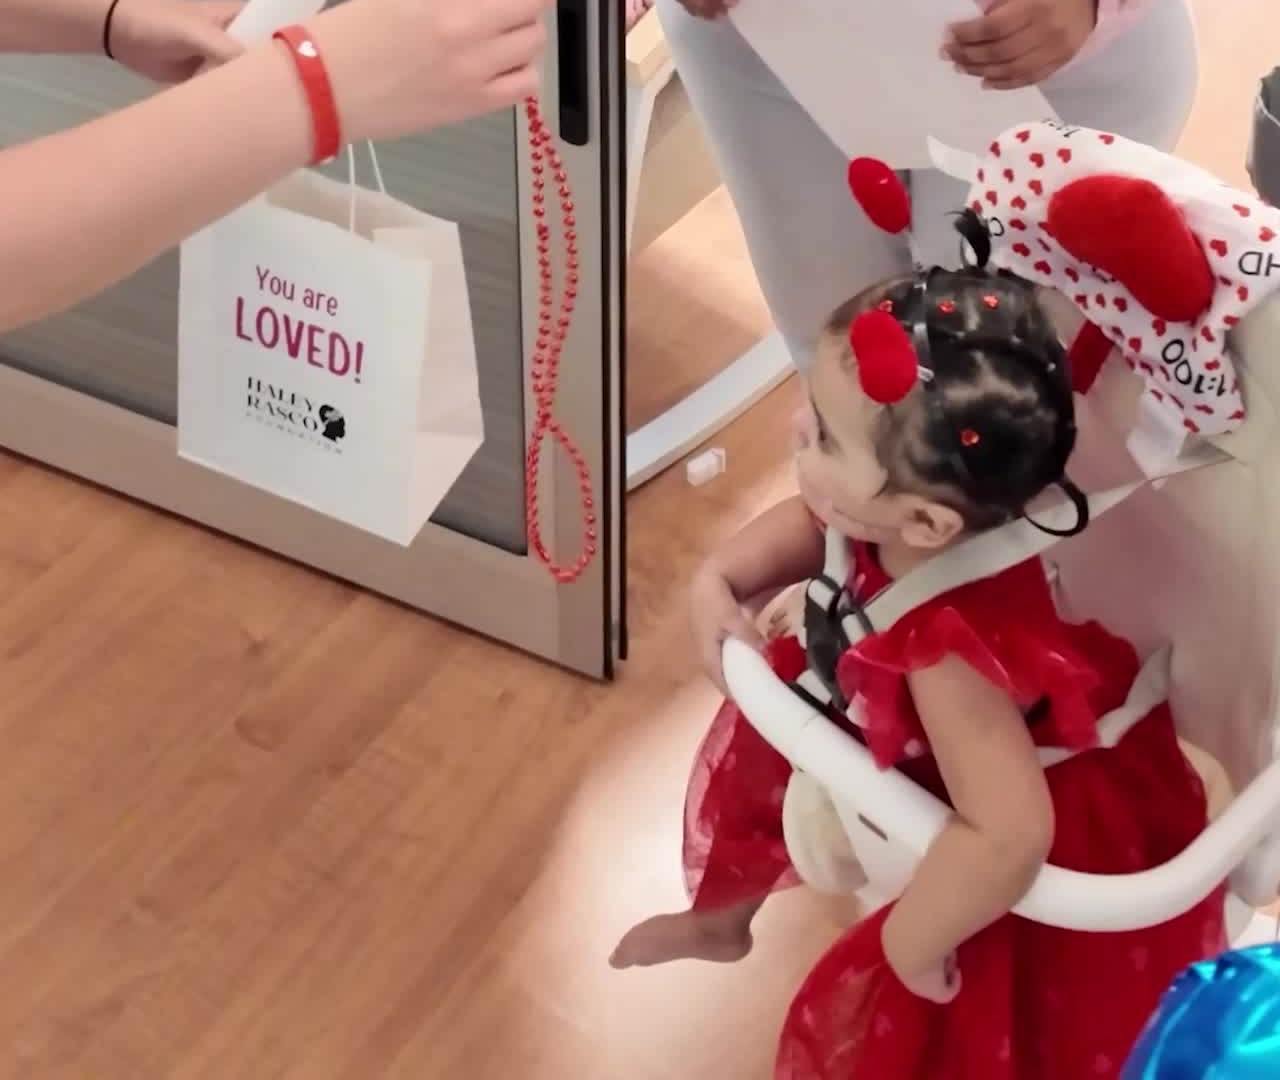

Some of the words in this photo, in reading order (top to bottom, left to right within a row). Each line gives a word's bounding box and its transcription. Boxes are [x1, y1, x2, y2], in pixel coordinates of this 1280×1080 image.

[255, 264, 295, 301] You
[303, 287, 338, 317] are
[236, 295, 364, 384] LOVED!
[1161, 338, 1226, 397] 1:100
